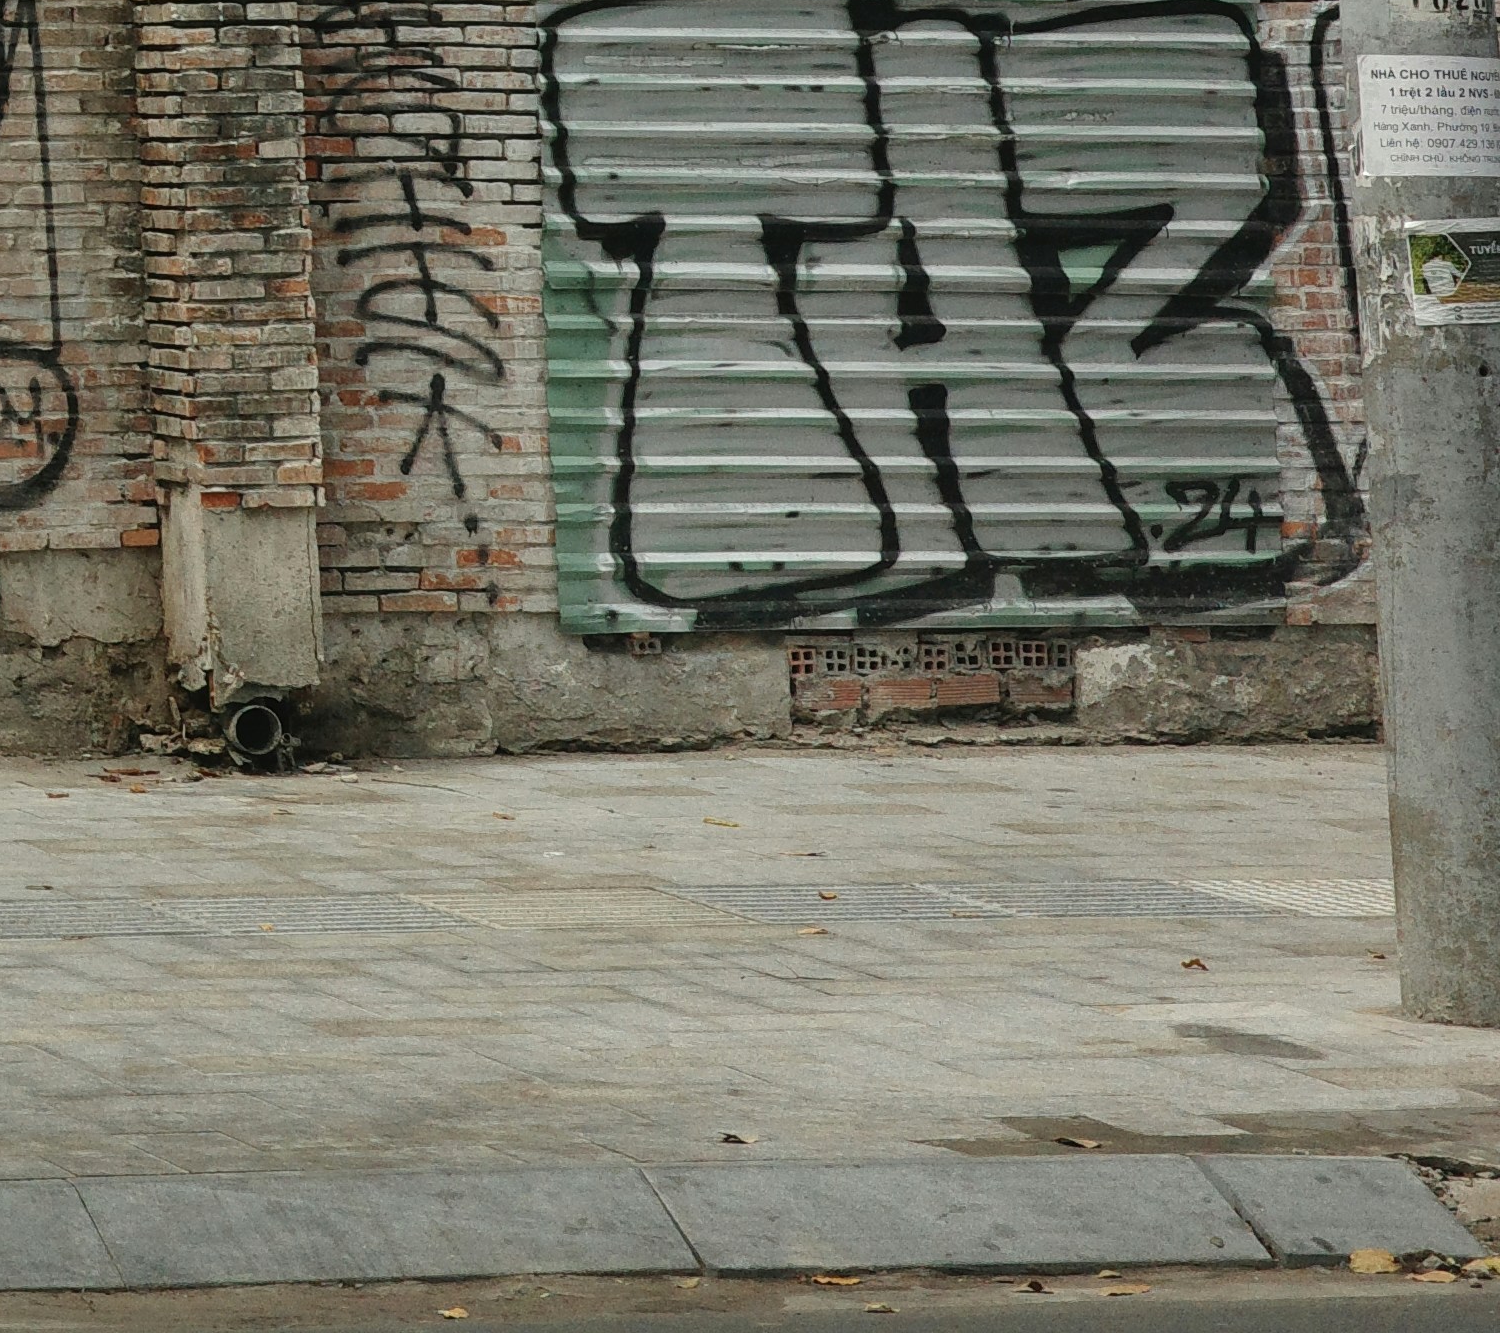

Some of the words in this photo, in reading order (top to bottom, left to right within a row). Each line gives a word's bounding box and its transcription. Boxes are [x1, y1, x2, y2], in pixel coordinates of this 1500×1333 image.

[1370, 67, 1396, 80] NHÀ
[1400, 69, 1430, 80] CHO
[1434, 68, 1468, 80] THUÊ
[1389, 87, 1395, 97] 1
[1425, 88, 1433, 98] 2
[1459, 88, 1466, 98] 2
[1381, 105, 1387, 114] 7
